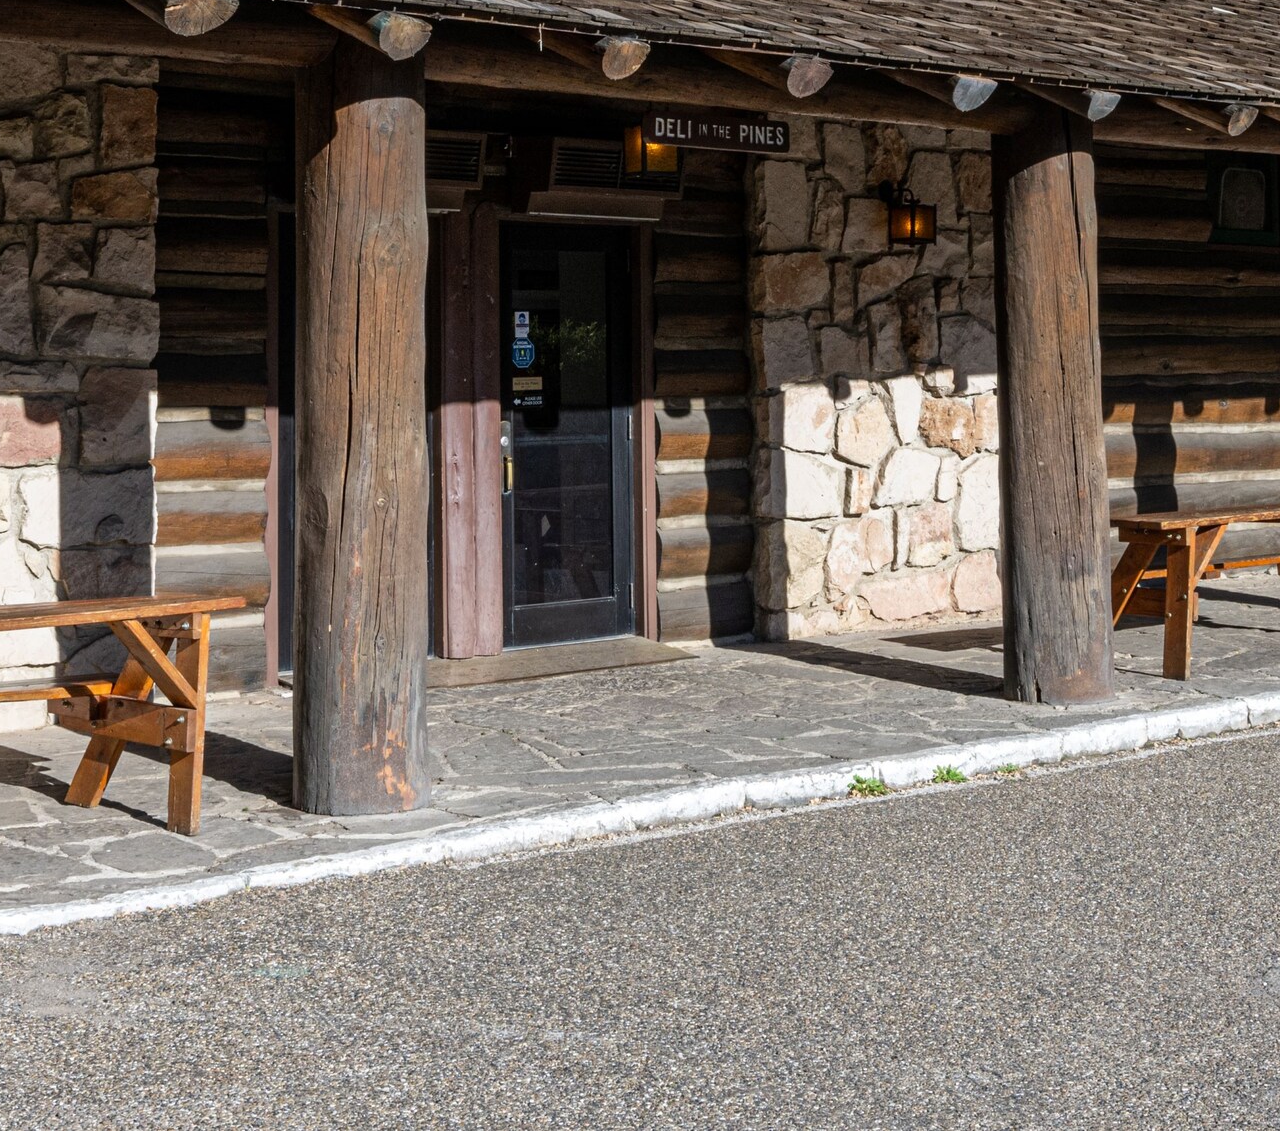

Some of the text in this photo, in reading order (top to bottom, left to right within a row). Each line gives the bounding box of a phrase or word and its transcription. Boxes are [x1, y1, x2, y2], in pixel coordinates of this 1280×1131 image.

[655, 117, 784, 146] DELI IN THE PINES
